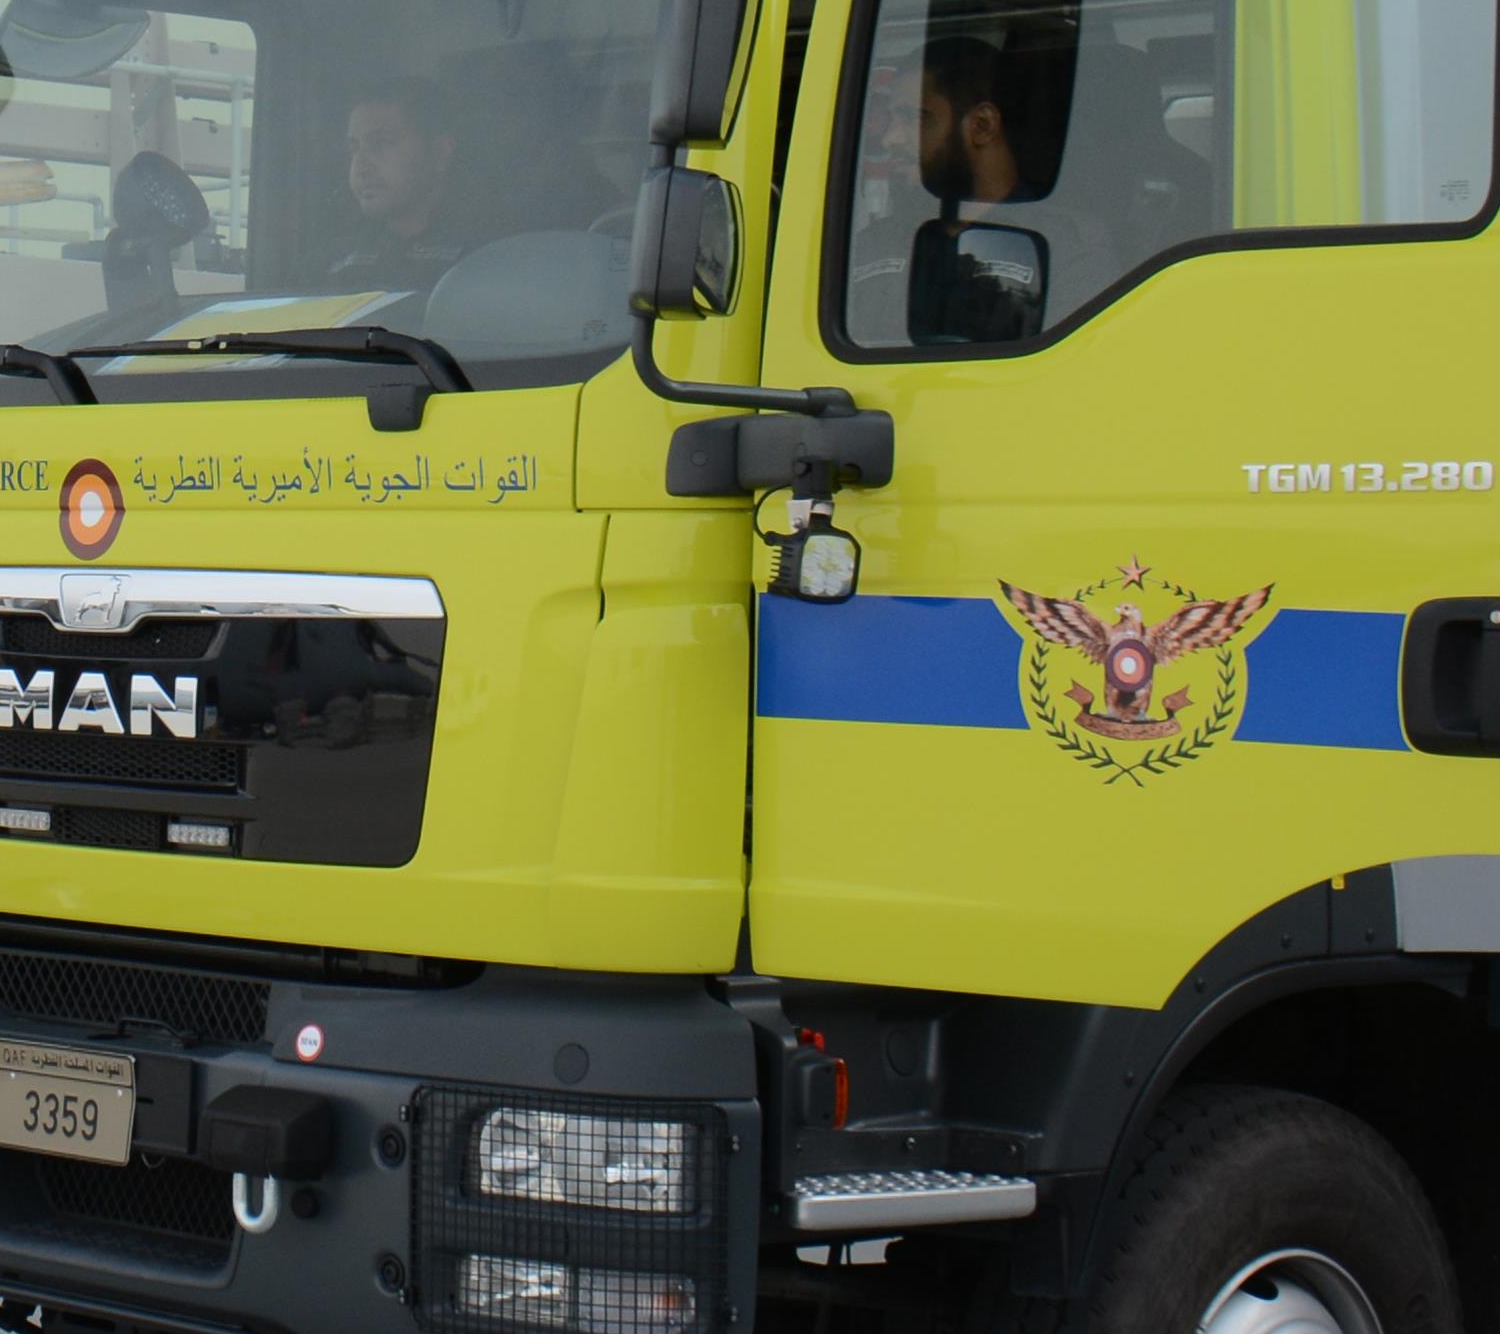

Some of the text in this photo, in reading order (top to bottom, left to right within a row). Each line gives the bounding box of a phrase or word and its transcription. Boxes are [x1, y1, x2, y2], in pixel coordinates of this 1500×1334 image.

[133, 447, 537, 503] القوات الجوية الأميرية القطرية
[1241, 460, 1494, 493] TGM 13.280
[3, 1048, 26, 1066] QAF
[24, 1090, 98, 1141] 3359
